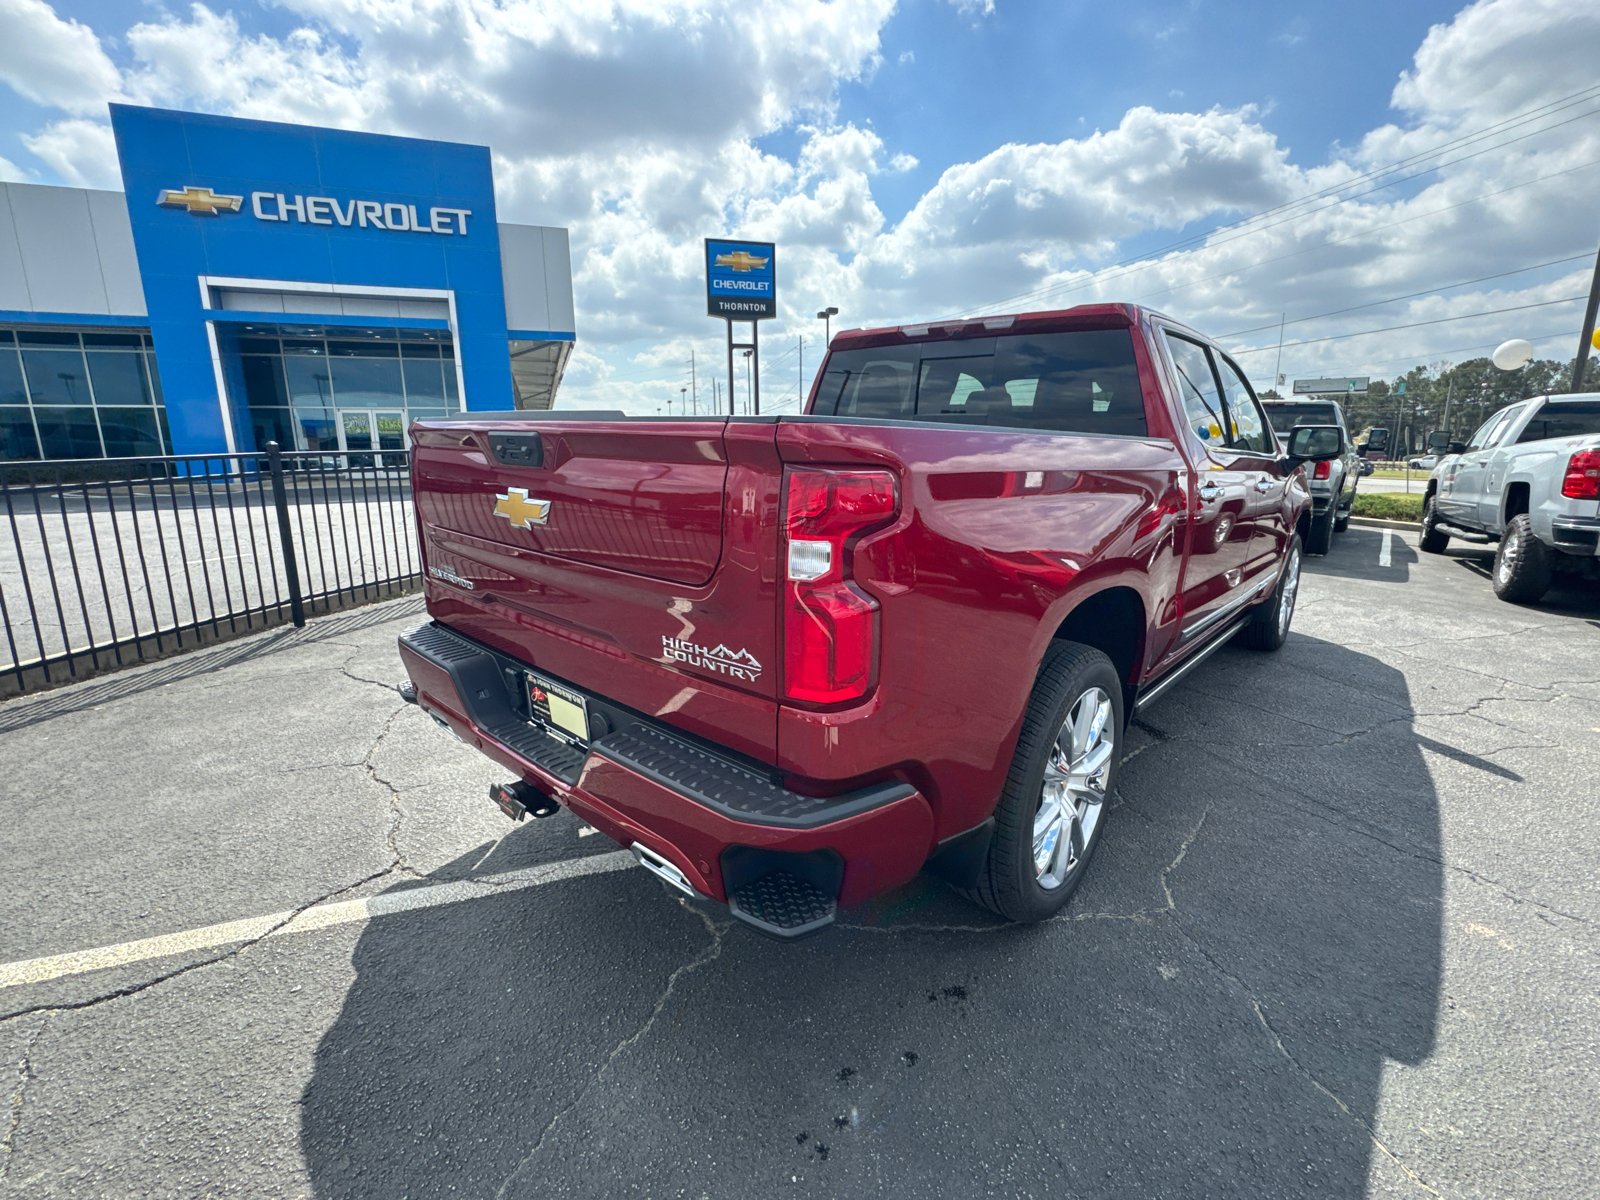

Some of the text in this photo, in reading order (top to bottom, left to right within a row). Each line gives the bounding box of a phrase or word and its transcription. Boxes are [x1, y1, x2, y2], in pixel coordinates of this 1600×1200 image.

[251, 191, 472, 235] CHEVROLET
[713, 279, 770, 291] CHEVROLET
[719, 302, 766, 312] THORNTON
[661, 635, 708, 656] HIGH
[663, 647, 762, 682] COUNTRY
